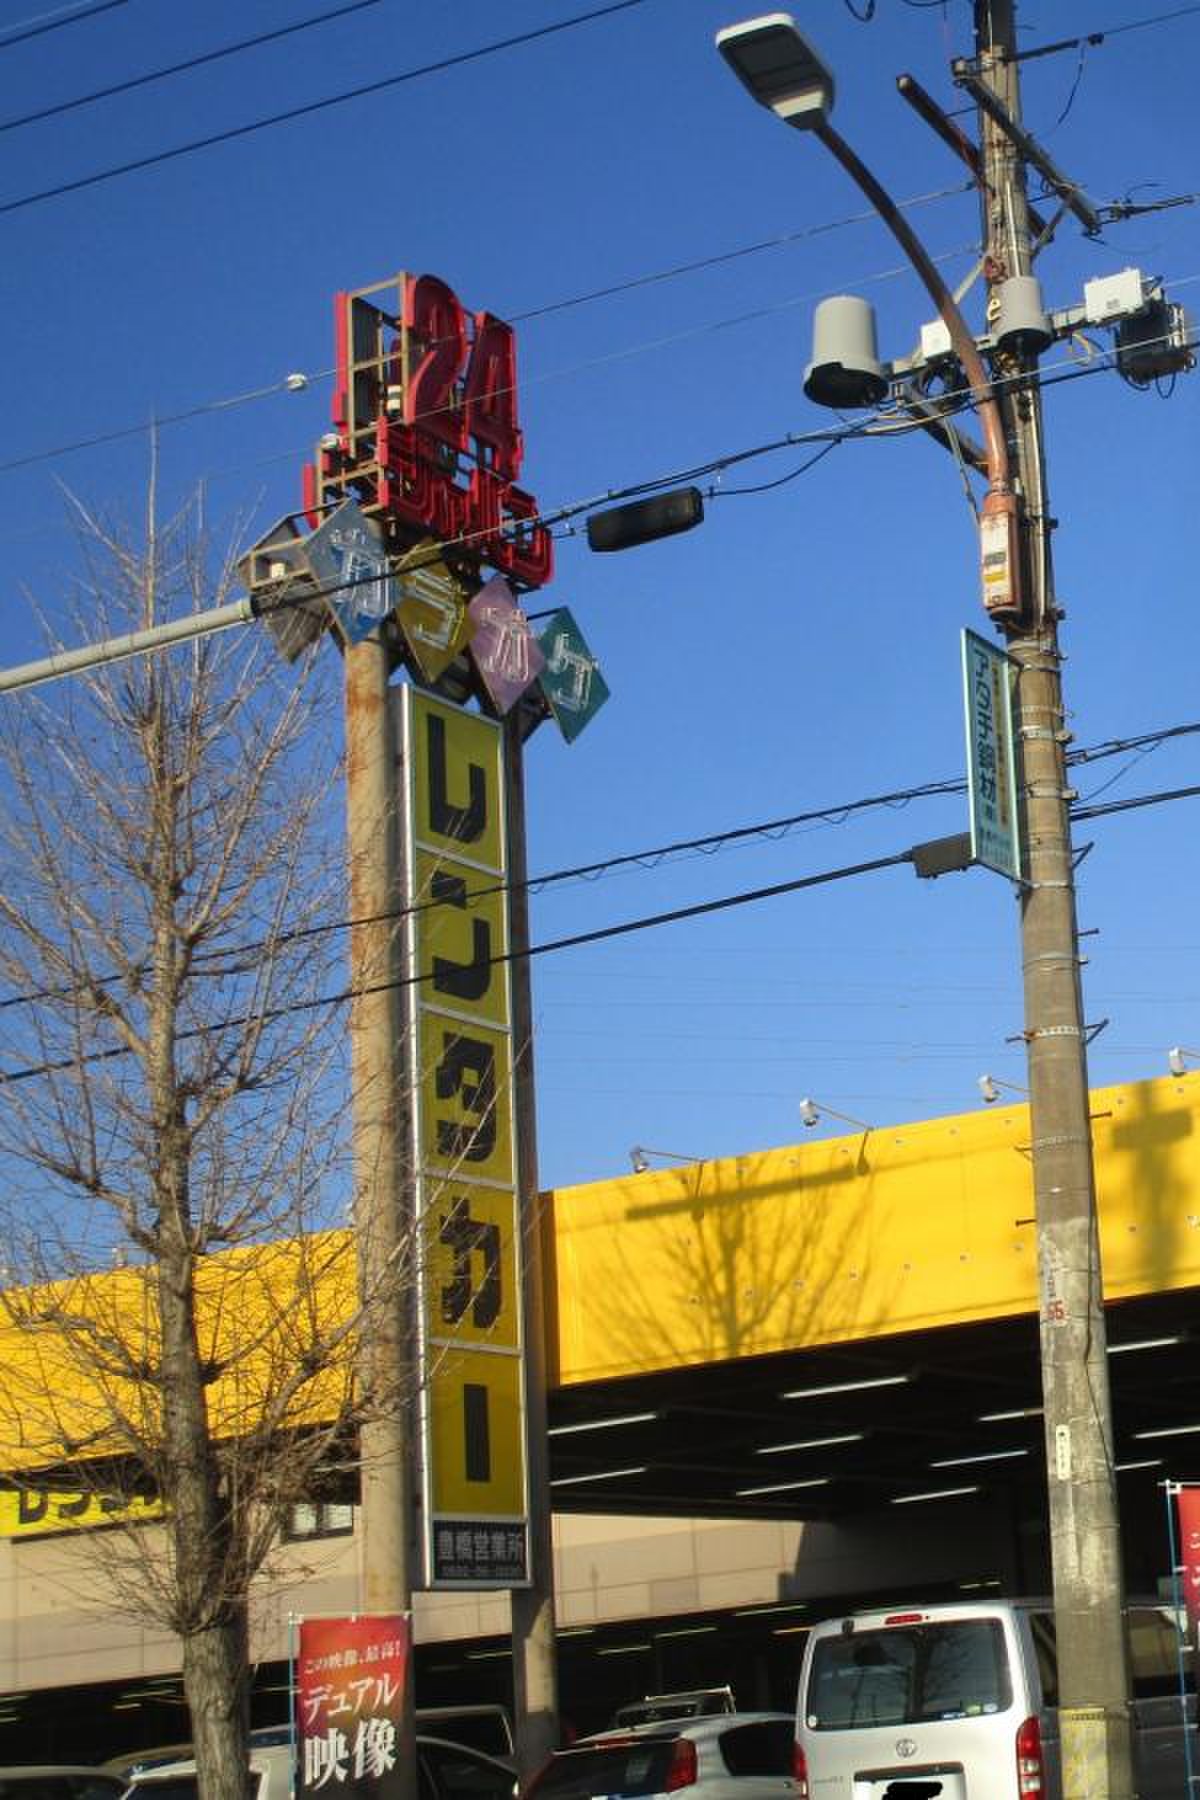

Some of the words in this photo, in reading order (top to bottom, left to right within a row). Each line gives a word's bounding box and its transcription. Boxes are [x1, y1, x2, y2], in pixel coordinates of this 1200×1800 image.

[304, 1673, 400, 1726] デュアル
[304, 1717, 398, 1791] 映像
